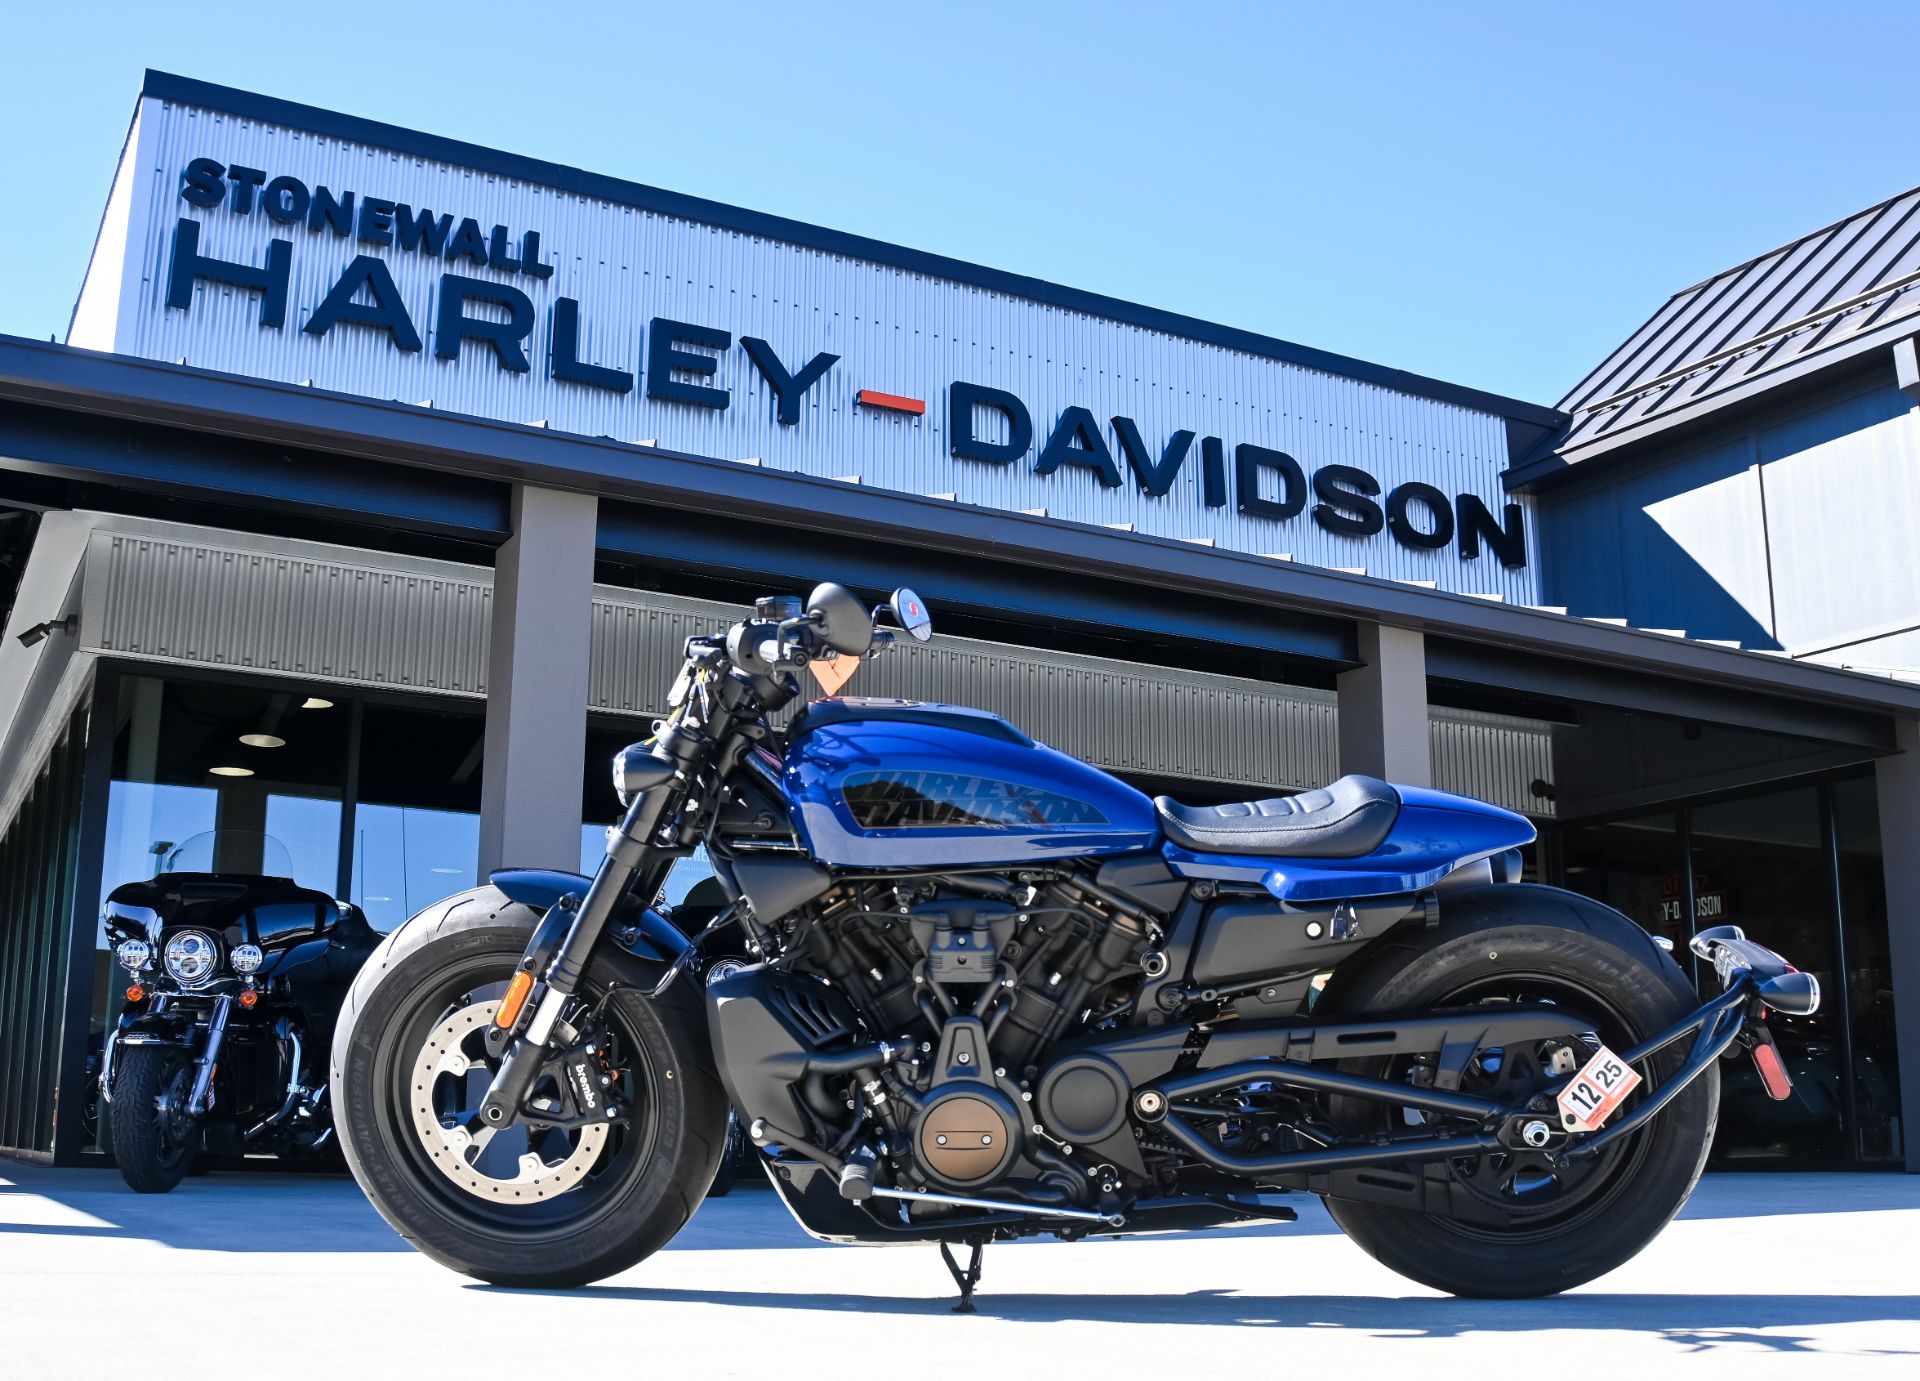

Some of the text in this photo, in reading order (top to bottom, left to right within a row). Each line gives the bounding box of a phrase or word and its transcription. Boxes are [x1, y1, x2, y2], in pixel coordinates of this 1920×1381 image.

[181, 157, 554, 280] STONEWALL
[575, 1063, 596, 1109] brembo
[1571, 1082, 1602, 1111] 12
[1595, 1059, 1623, 1089] 25
